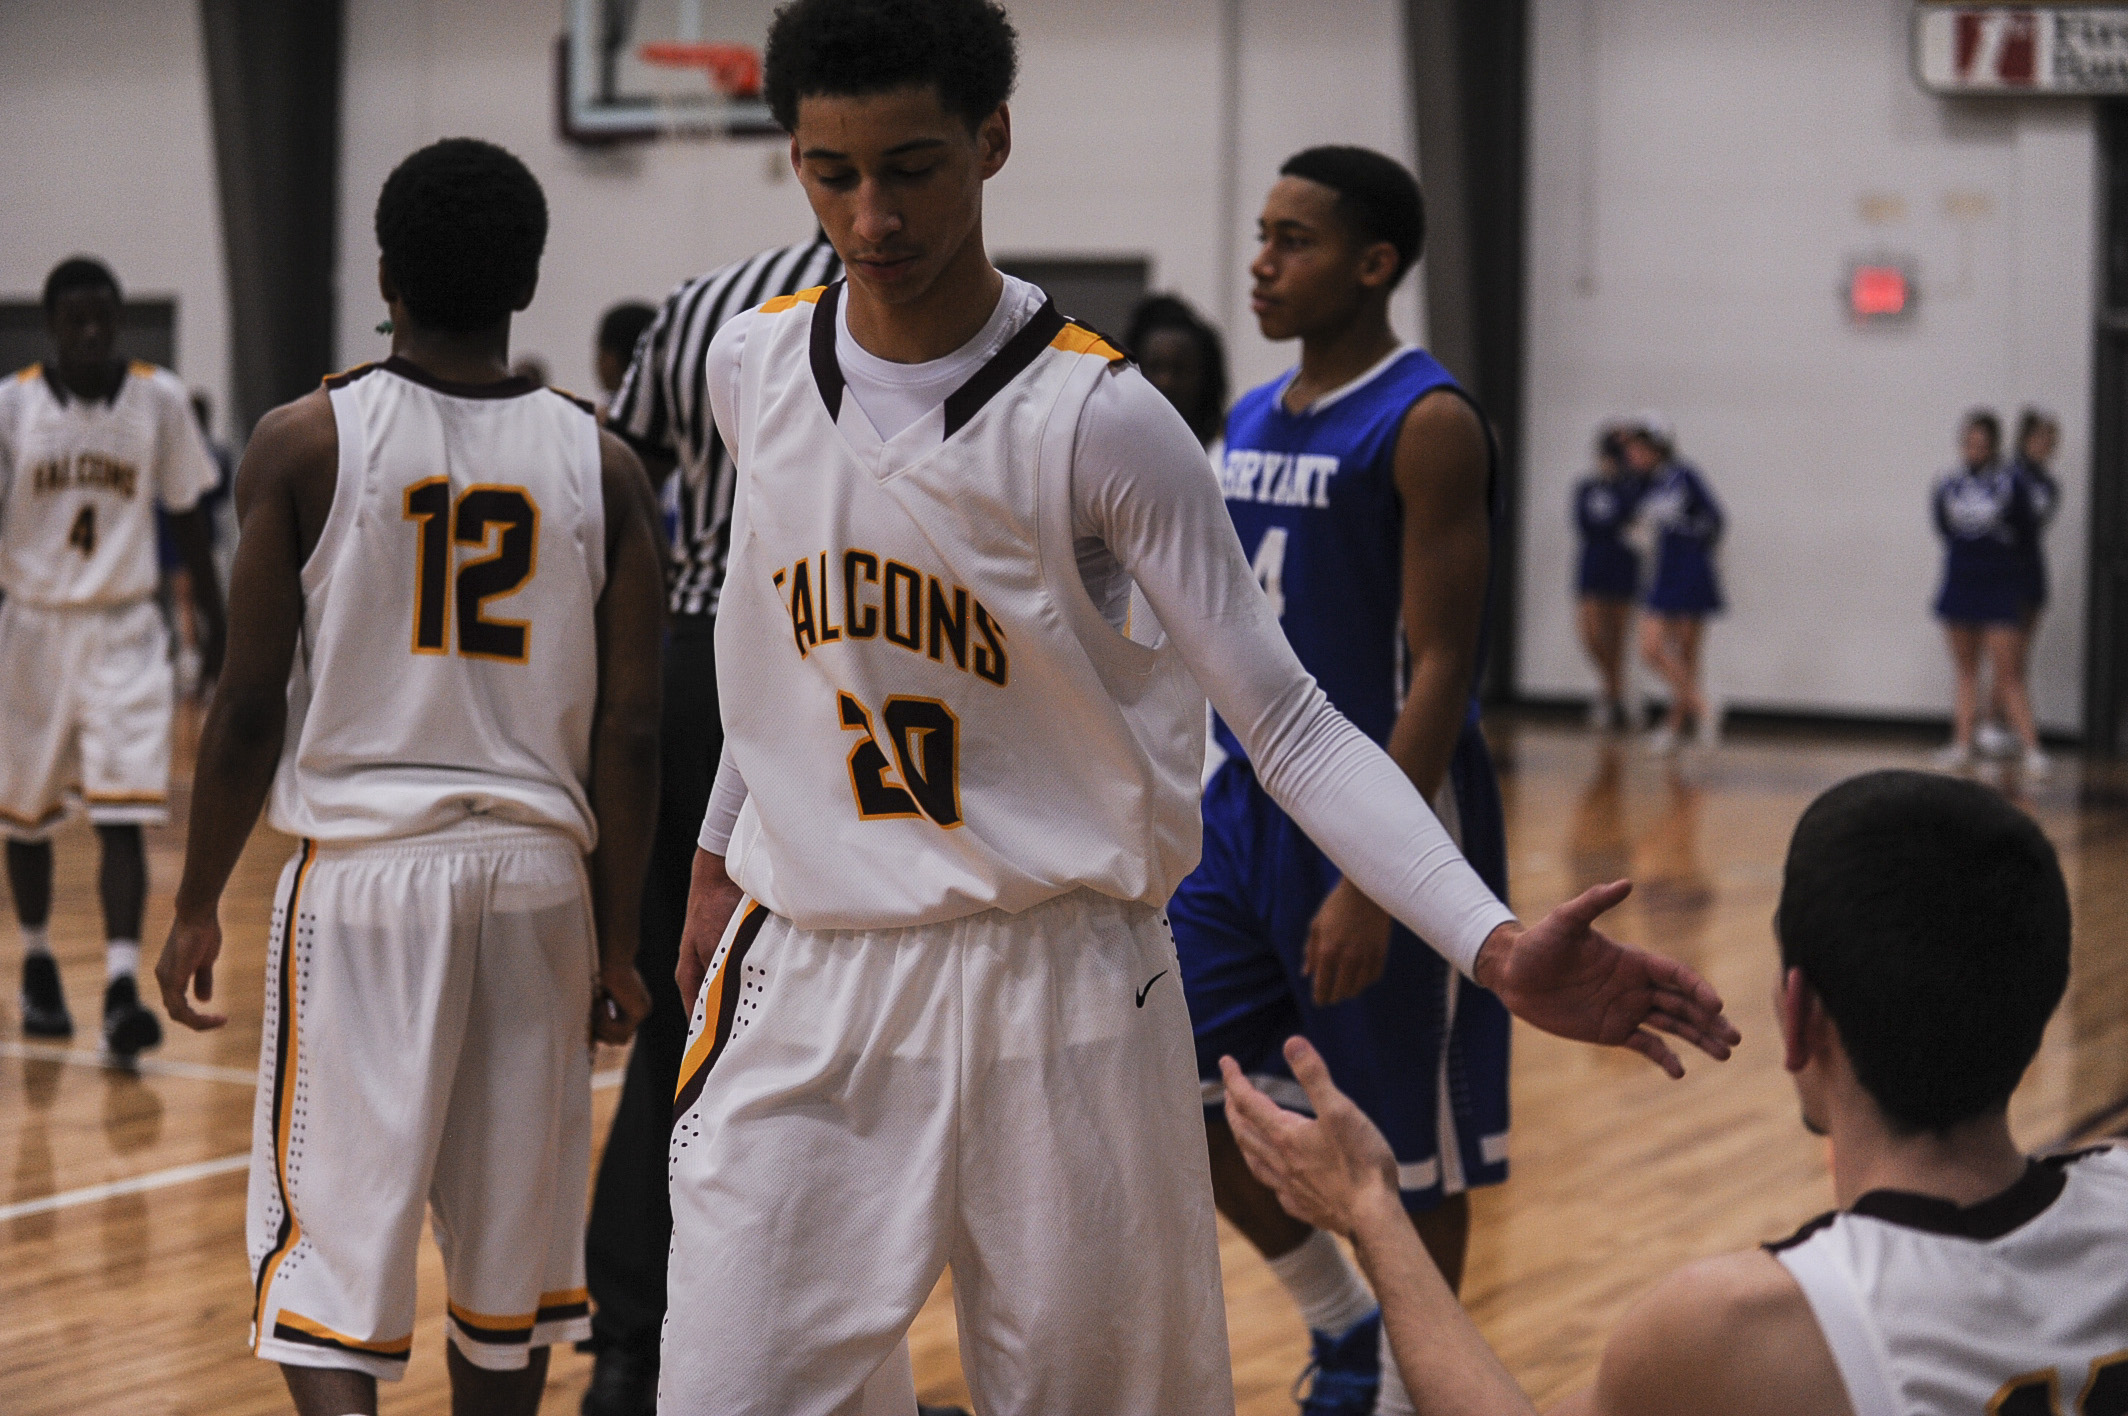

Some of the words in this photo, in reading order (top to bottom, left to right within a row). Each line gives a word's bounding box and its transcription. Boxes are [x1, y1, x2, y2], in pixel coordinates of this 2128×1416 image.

[69, 502, 98, 559] 4
[402, 474, 541, 666] 12
[837, 689, 964, 830] 20
